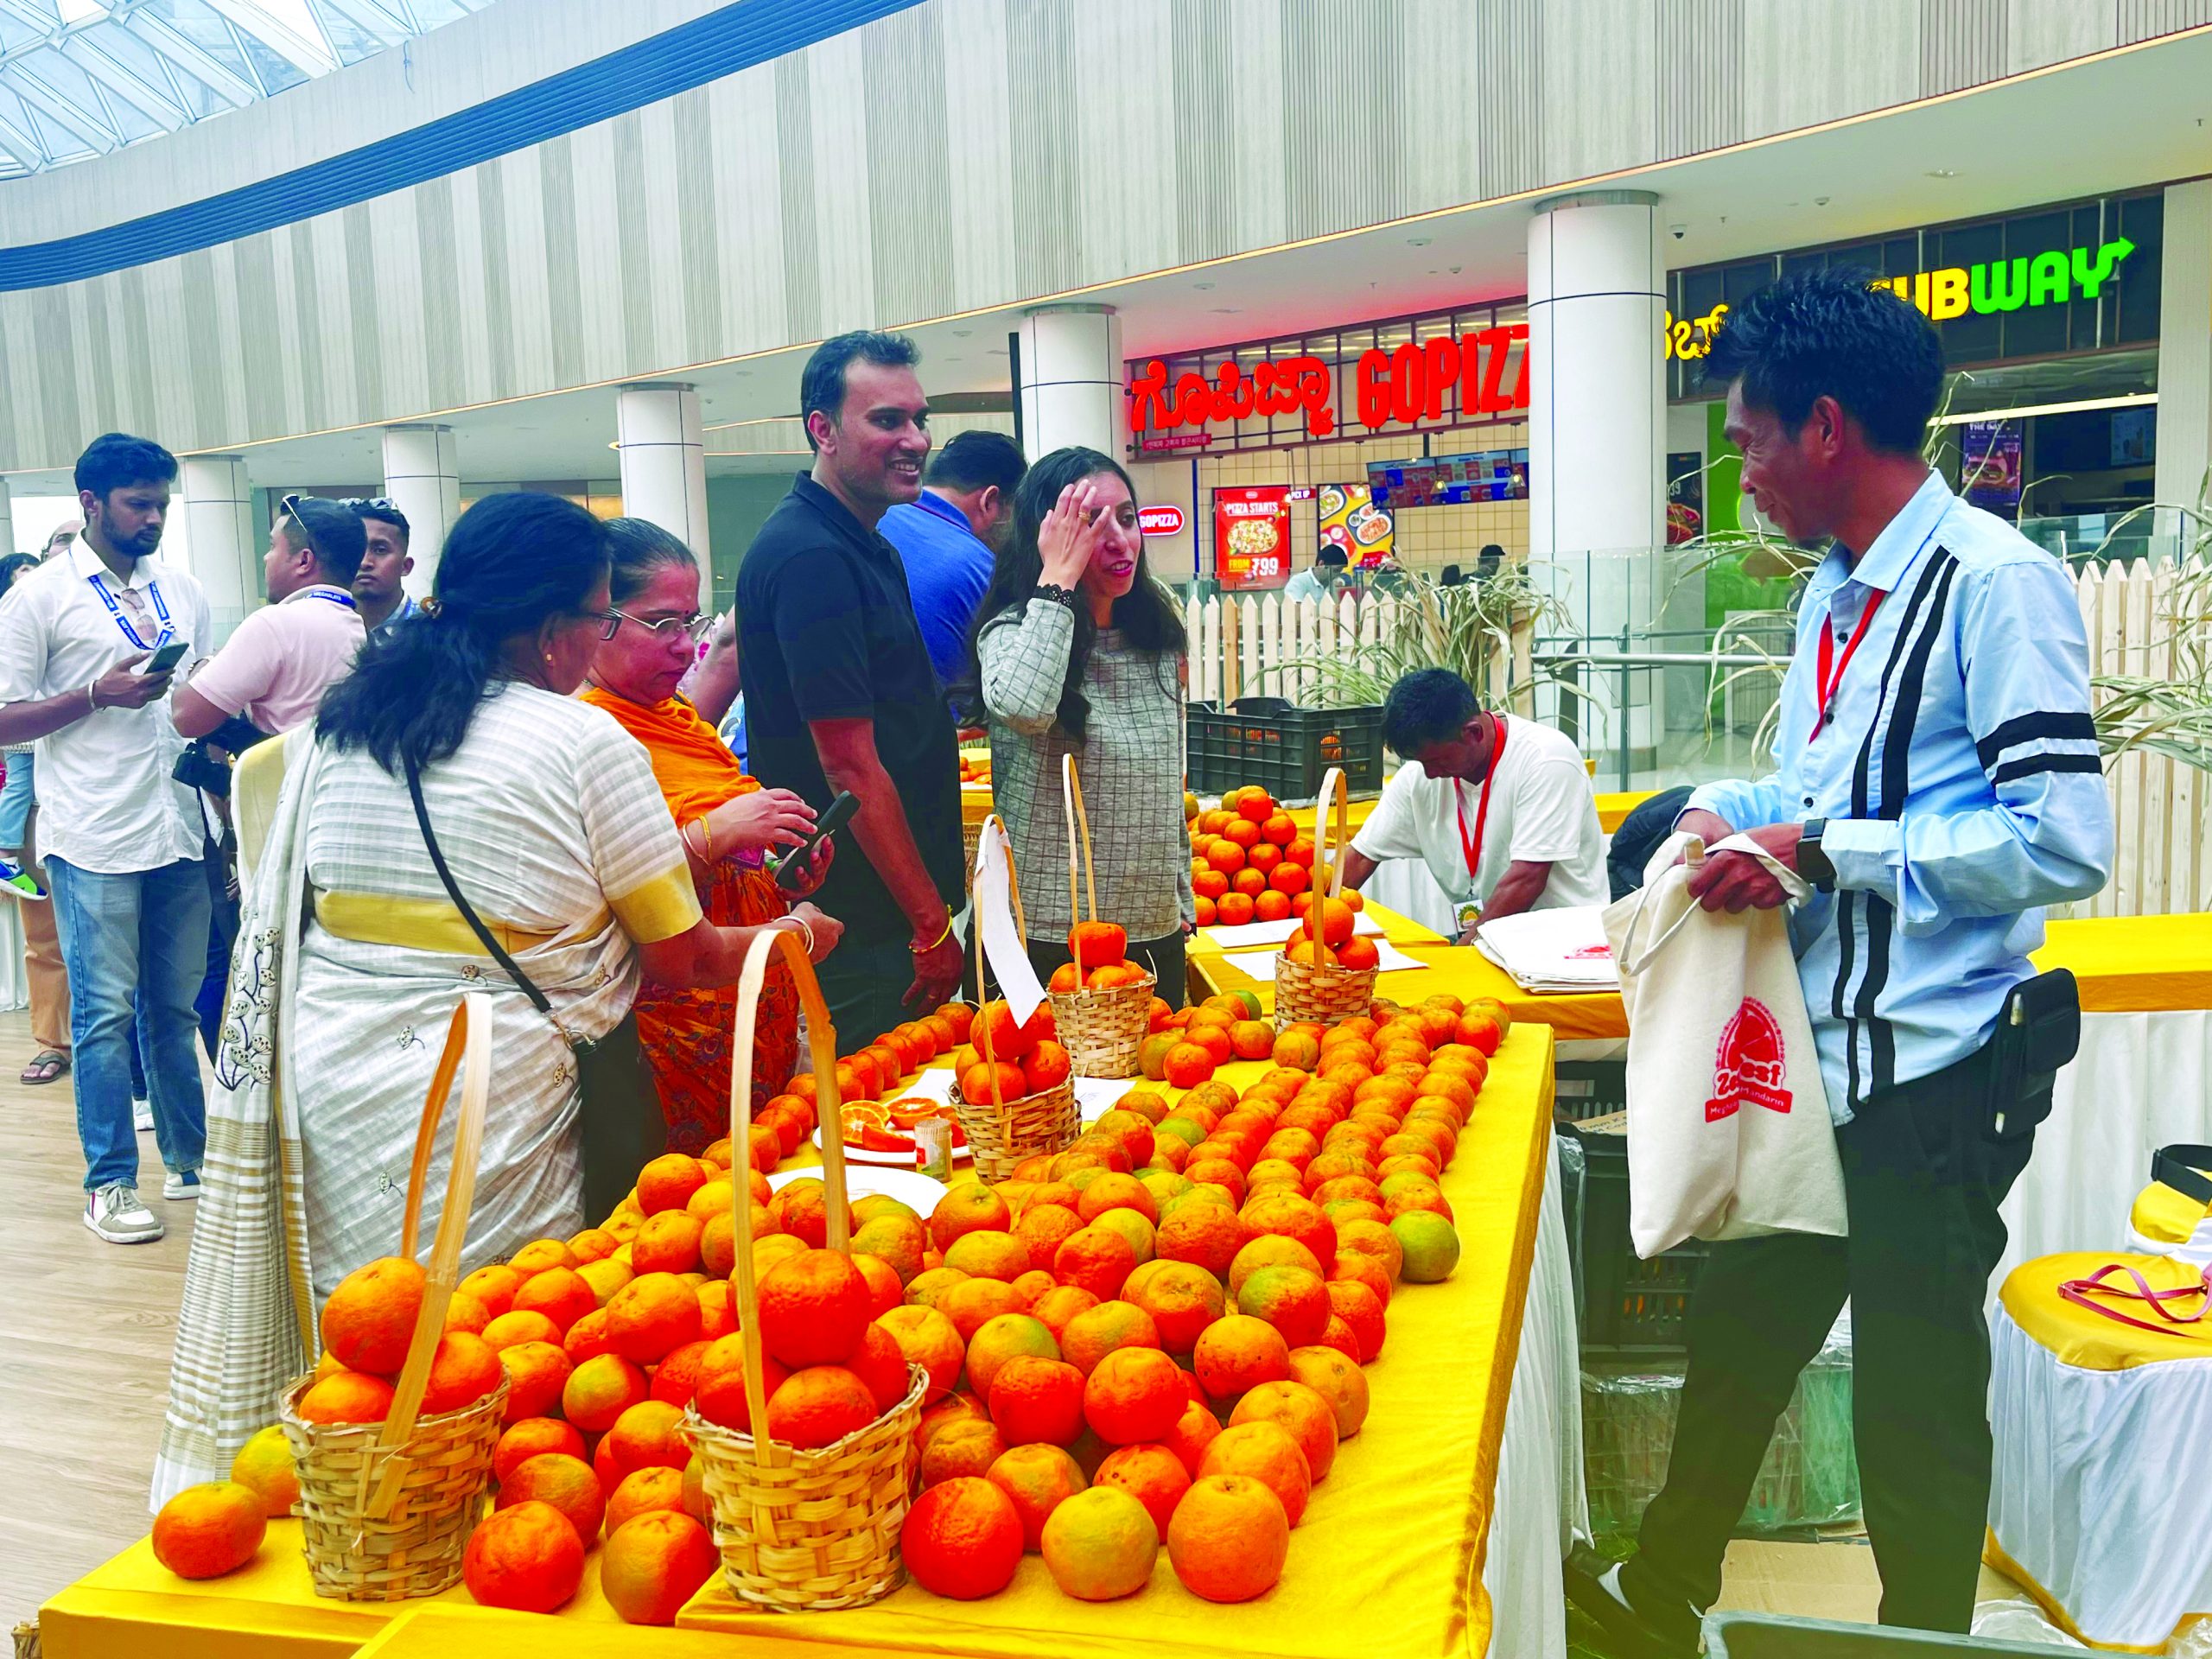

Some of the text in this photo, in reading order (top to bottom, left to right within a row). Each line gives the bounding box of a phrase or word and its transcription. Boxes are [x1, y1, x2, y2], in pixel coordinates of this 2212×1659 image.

[1866, 237, 2135, 321] UBWAY
[1226, 501, 1278, 515] PIZZA STARTS
[1229, 559, 1249, 569] FROM
